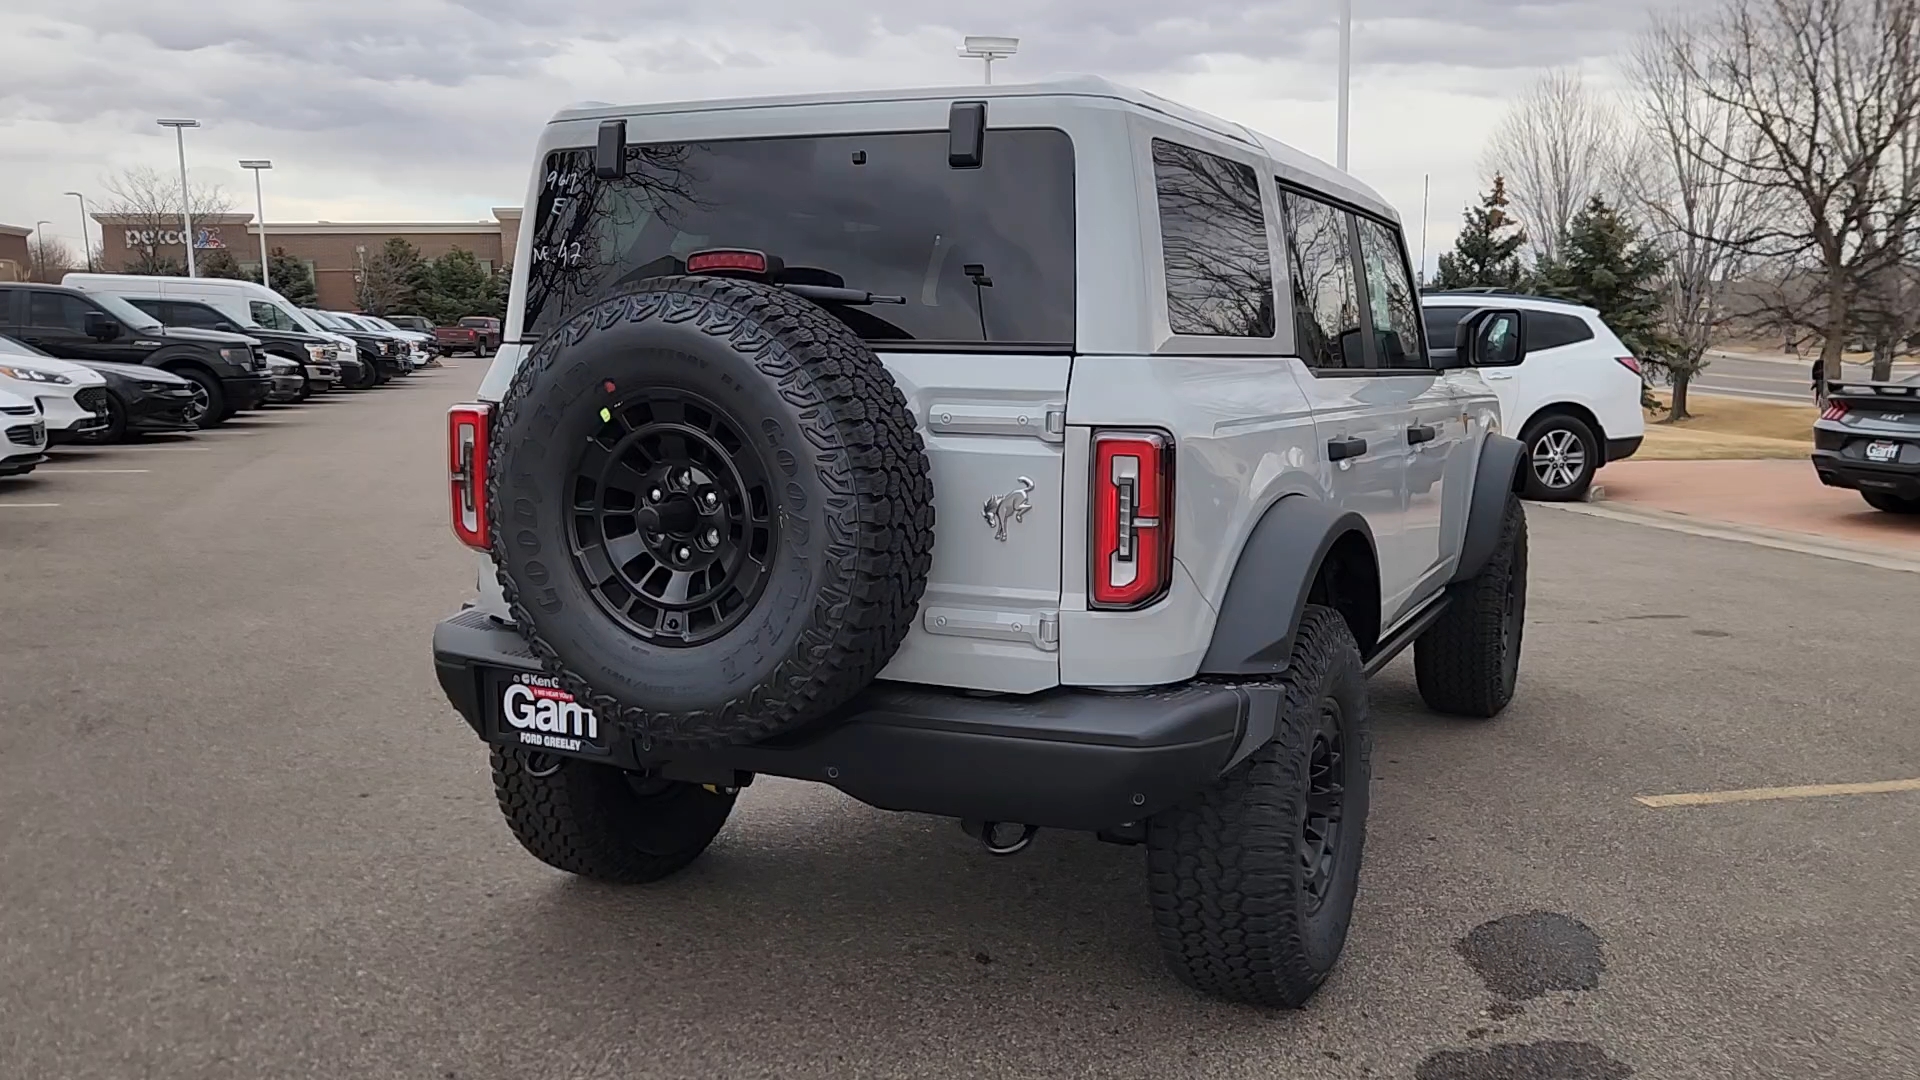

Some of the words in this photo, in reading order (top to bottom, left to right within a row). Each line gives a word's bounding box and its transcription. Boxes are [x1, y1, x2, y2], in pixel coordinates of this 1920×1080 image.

[530, 674, 551, 688] Ken
[520, 732, 542, 746] FORD
[543, 735, 581, 751] GREELEY
